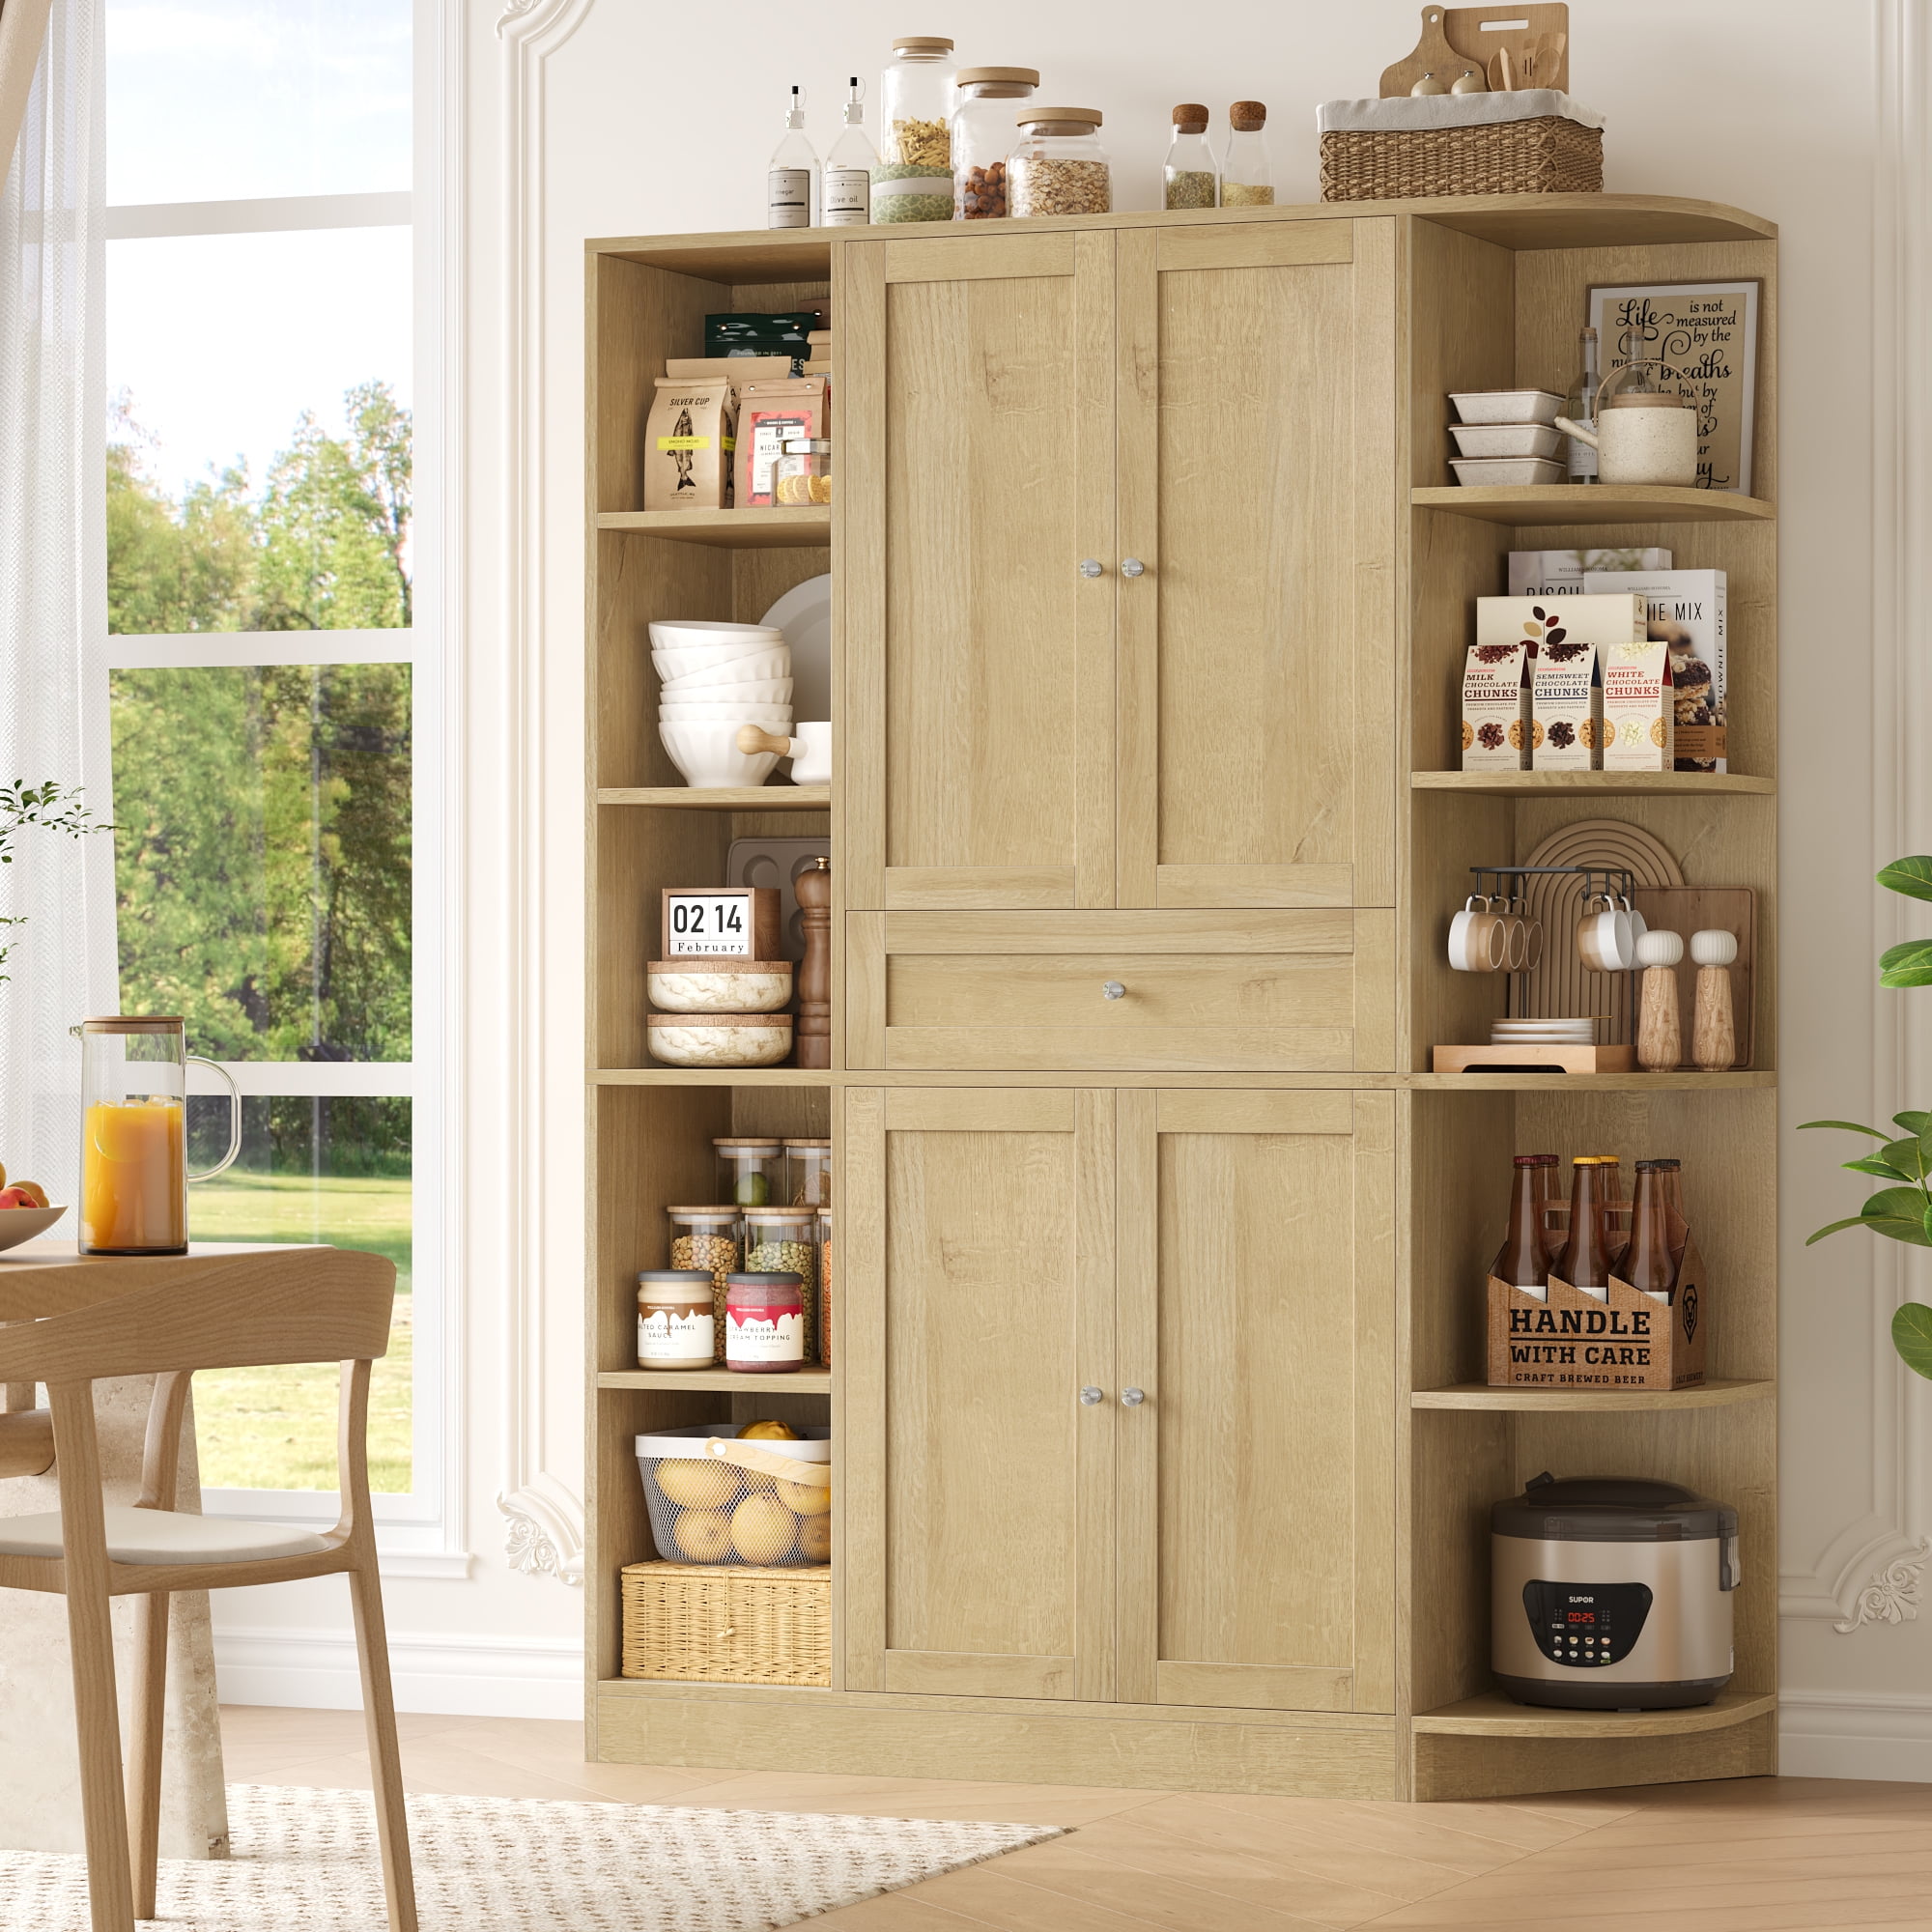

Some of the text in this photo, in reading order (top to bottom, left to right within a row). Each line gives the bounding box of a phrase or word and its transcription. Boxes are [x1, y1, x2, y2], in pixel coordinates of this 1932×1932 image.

[1690, 299, 1724, 313] is not
[1616, 298, 1674, 341] Life
[1677, 310, 1737, 327] measured
[1693, 327, 1731, 347] by the
[1703, 383, 1718, 401] by
[695, 397, 710, 406] CUP
[1701, 398, 1716, 418] of
[1675, 602, 1702, 621] MIX
[1464, 689, 1518, 698] CHUNKS
[1535, 688, 1588, 696] CHUNKS
[1605, 686, 1660, 696] CHUNKS
[673, 904, 743, 933] 02 14
[677, 942, 744, 953] February
[1510, 1309, 1651, 1335] HANDLE
[1511, 1346, 1650, 1366] WITH CARE
[1516, 1373, 1645, 1384] CRAFT BREWED BEER
